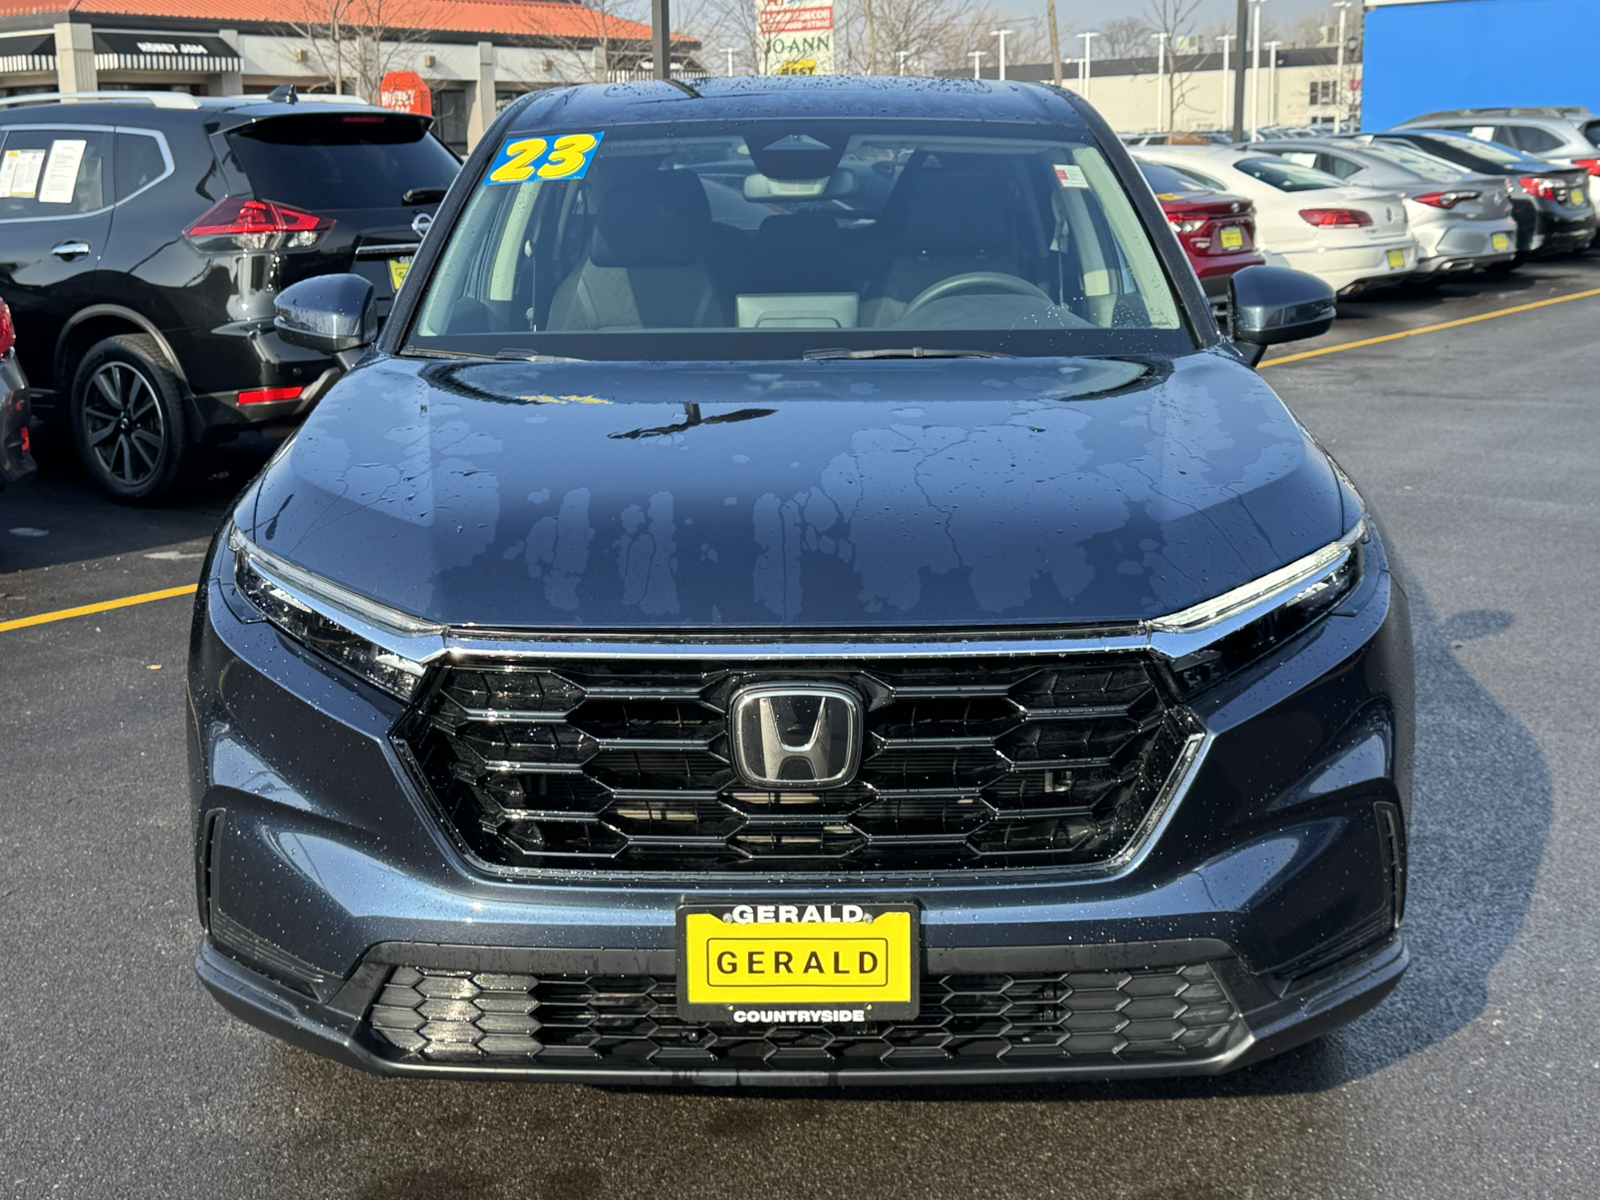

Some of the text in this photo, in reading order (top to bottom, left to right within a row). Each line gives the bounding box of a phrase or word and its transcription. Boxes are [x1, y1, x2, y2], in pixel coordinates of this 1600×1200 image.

[490, 134, 598, 182] 23
[732, 904, 864, 924] GERALD
[716, 950, 879, 975] GERALD
[733, 1009, 865, 1023] COUNTRYSIDE
